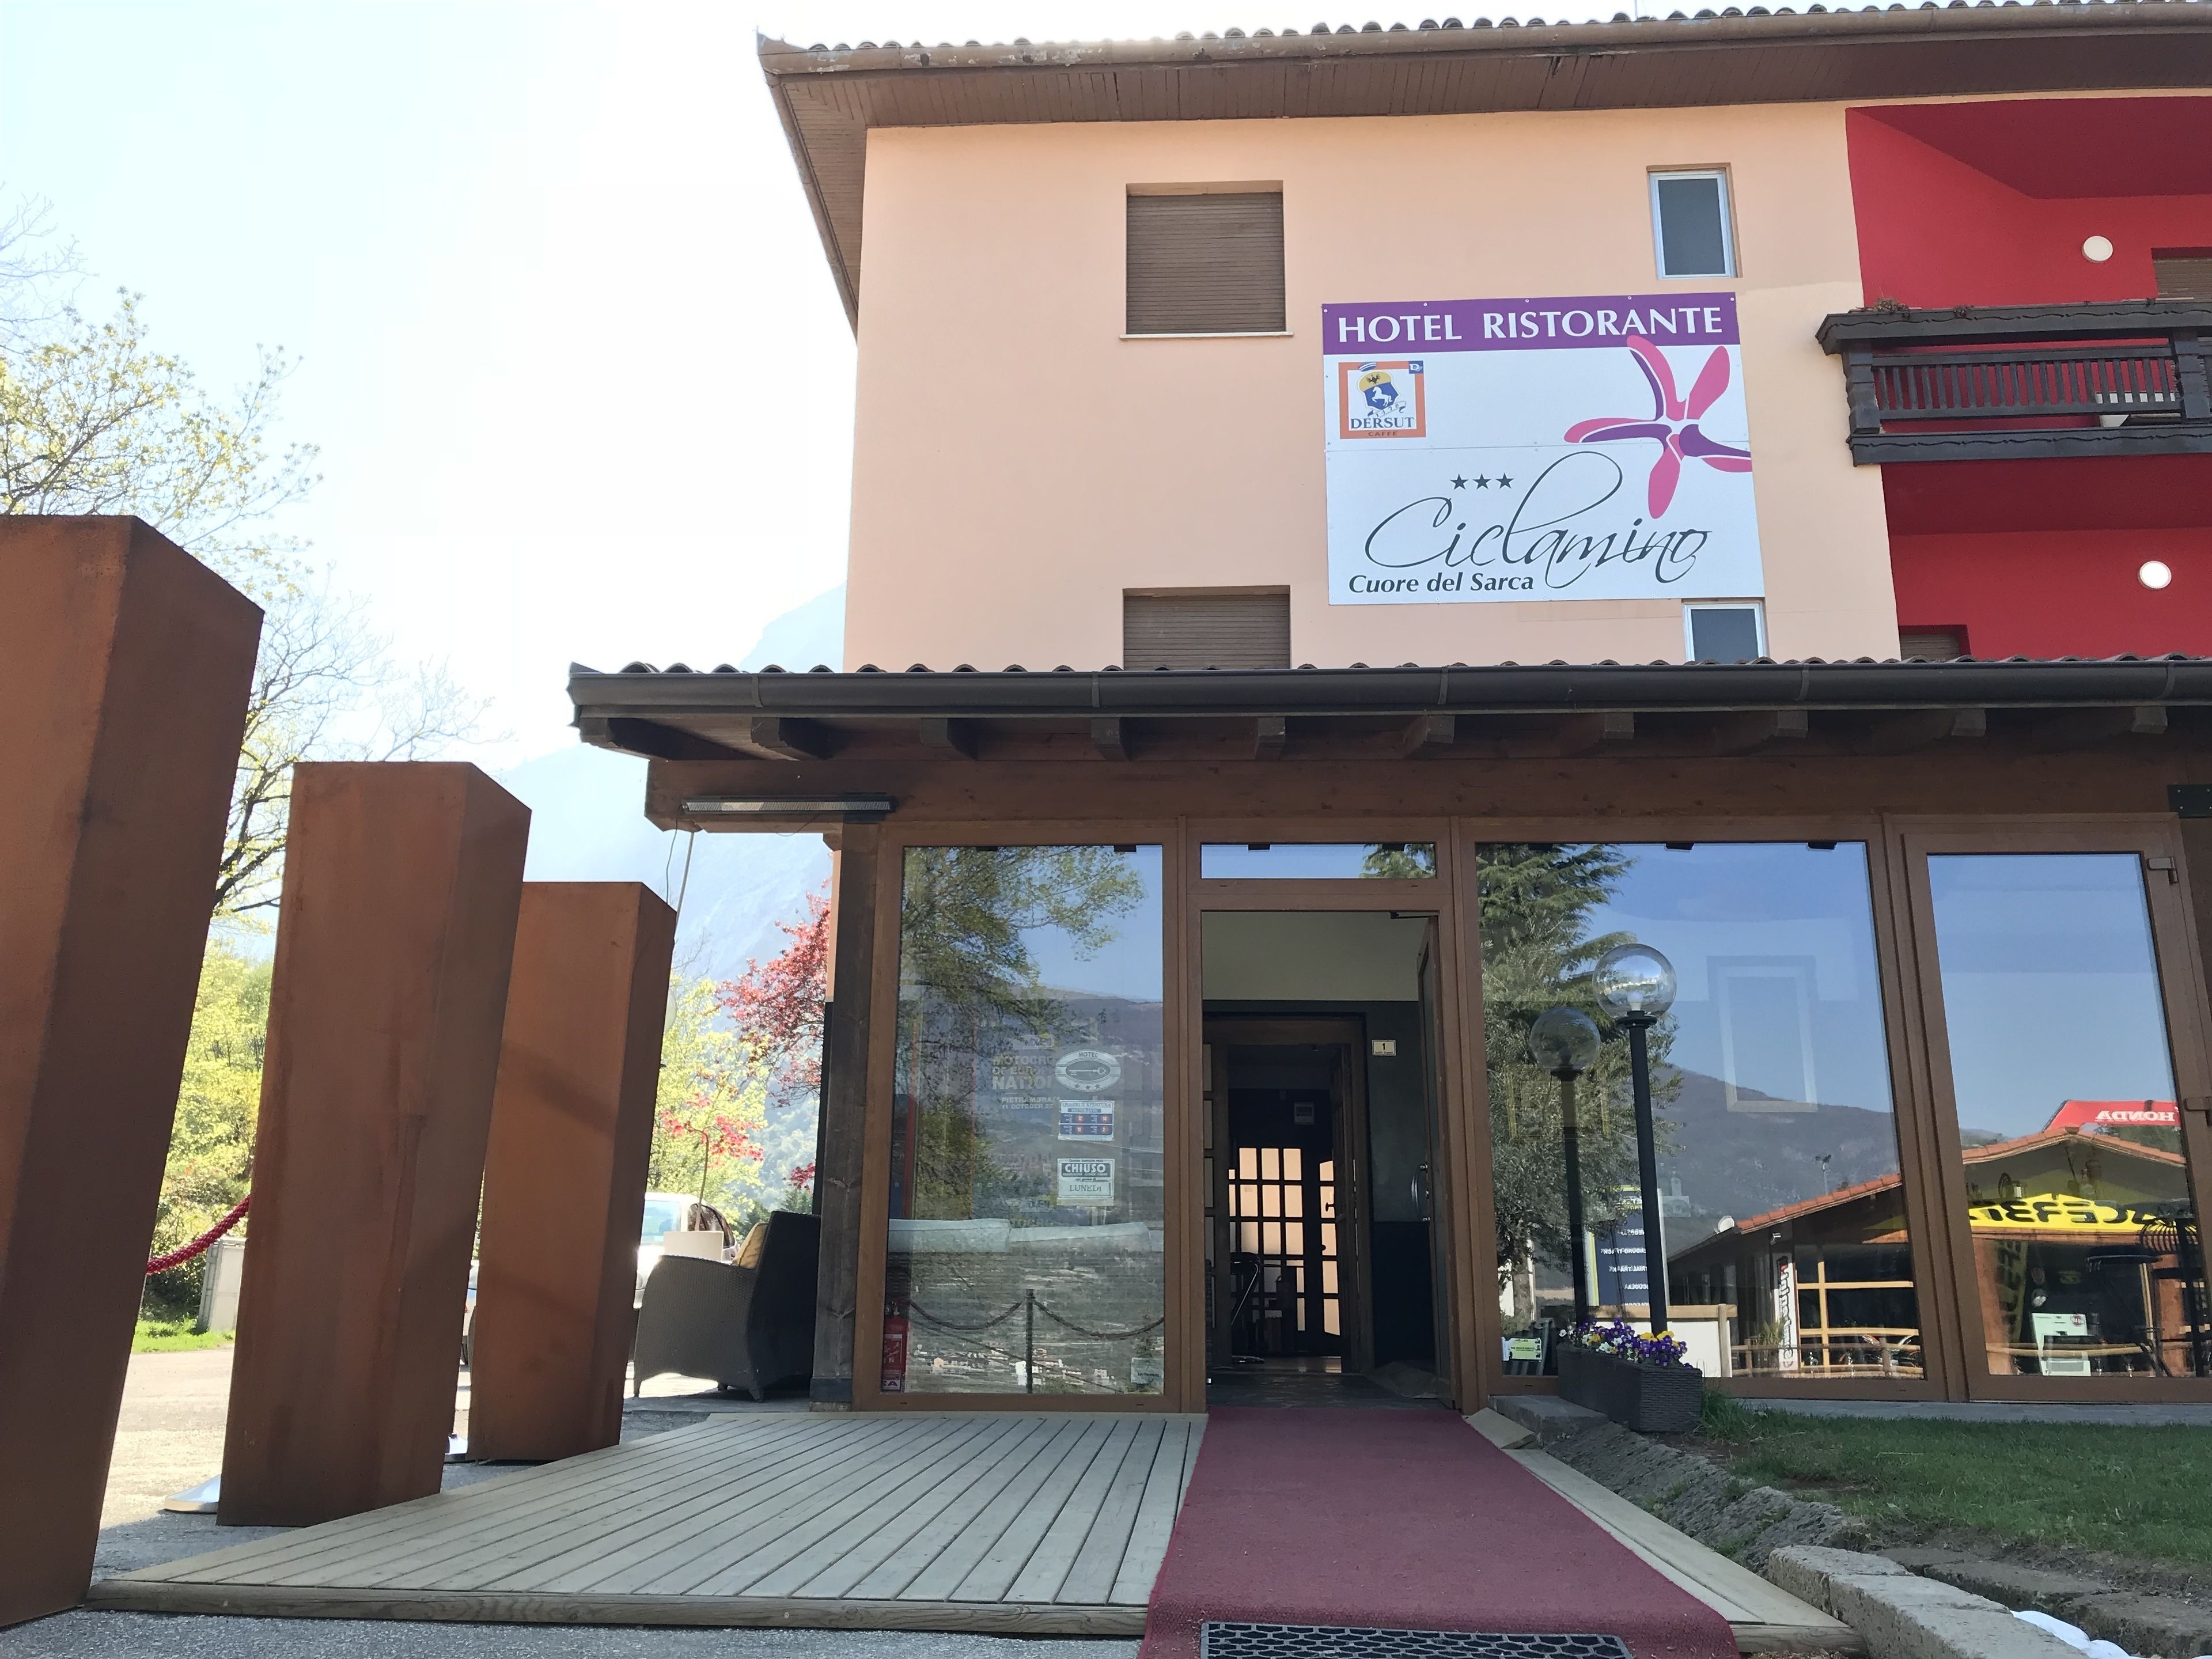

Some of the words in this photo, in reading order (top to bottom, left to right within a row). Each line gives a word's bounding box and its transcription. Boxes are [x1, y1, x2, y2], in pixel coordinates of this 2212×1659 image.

[1338, 314, 1462, 342] HOTEL
[1483, 307, 1722, 339] RISTORANTE
[1350, 416, 1415, 429] DERSUT
[1364, 450, 1712, 589] Ciclamino
[1349, 574, 1419, 593] Cuore
[1427, 572, 1462, 592] del
[1470, 573, 1533, 592] Sarca
[1382, 1042, 1385, 1050] 1
[1065, 1164, 1106, 1173] CHIUSO
